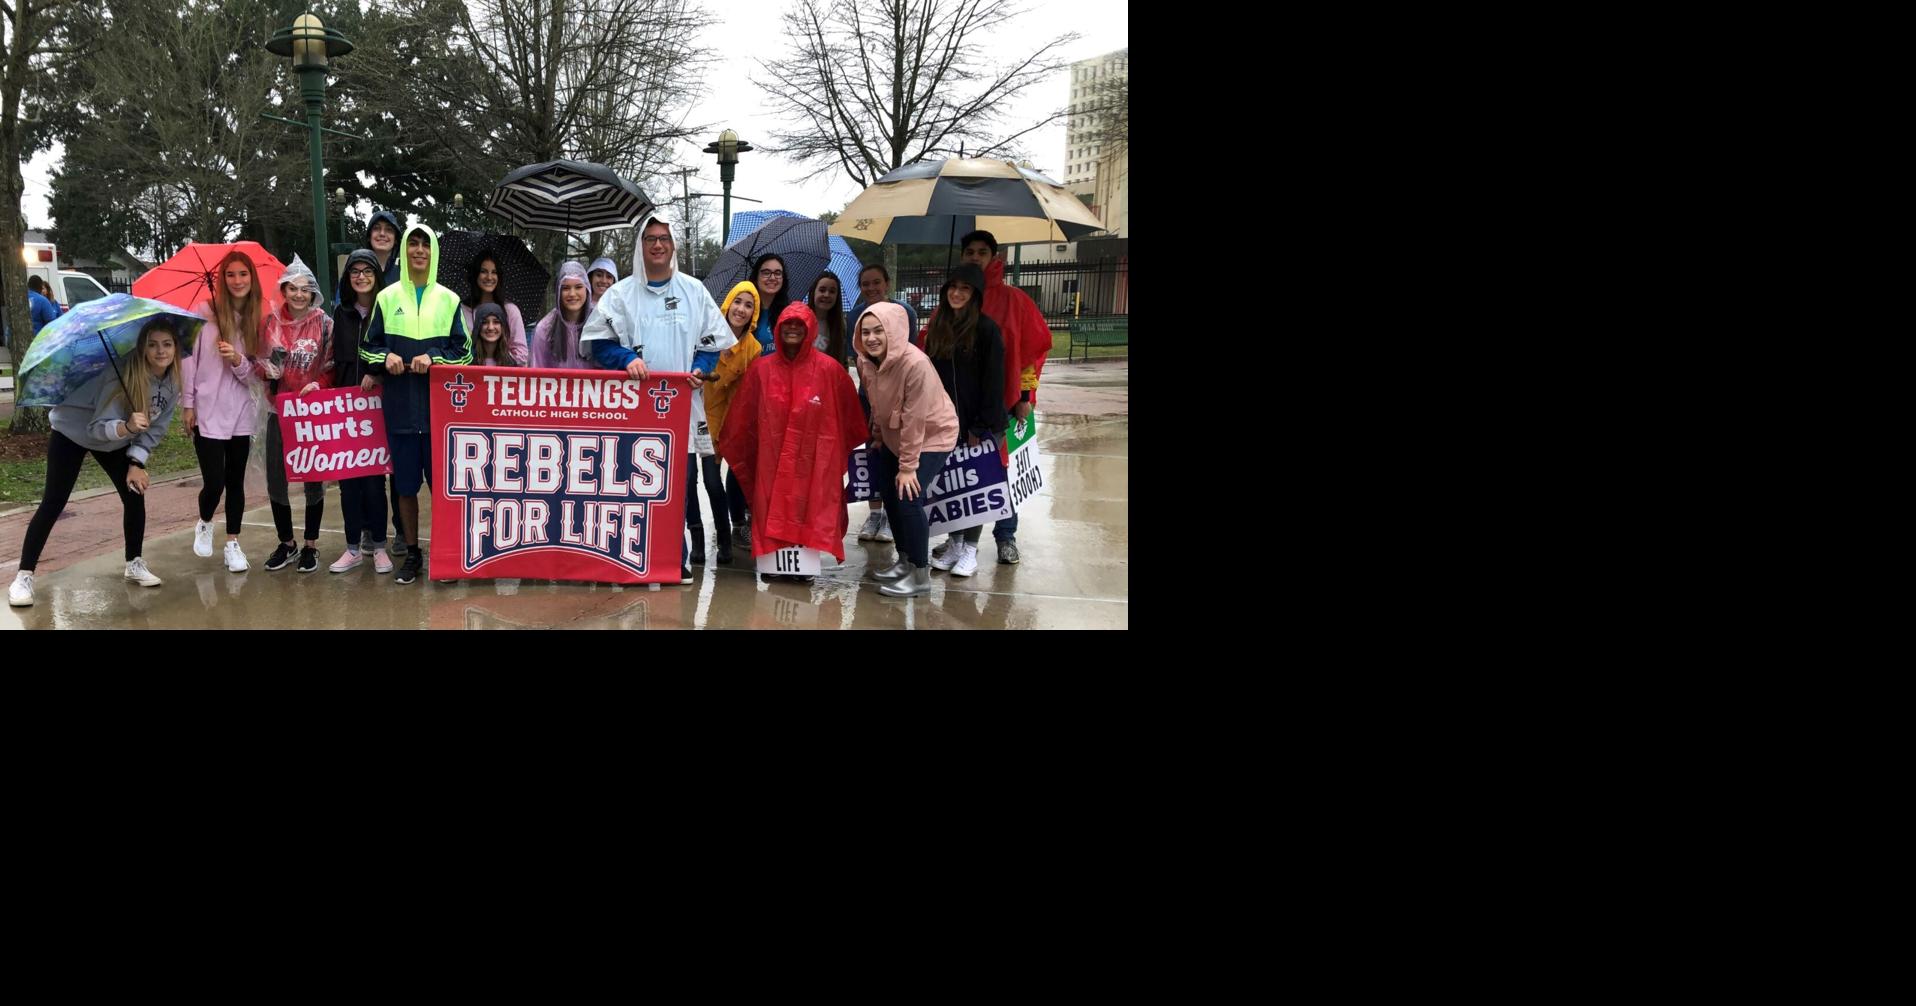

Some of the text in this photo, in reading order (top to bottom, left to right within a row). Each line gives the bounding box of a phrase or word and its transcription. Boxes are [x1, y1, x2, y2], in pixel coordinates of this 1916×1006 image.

[283, 393, 382, 417] Abortion
[483, 375, 641, 410] TEURLINGS
[295, 416, 374, 442] Hurts
[491, 408, 629, 420] CATHOLIC HIGH SCHOOL
[286, 444, 391, 474] Women
[452, 431, 666, 496] REBELS
[1015, 446, 1031, 477] LIFE
[926, 467, 979, 499] Kills
[1011, 465, 1042, 506] CHOOSE
[470, 498, 645, 567] FOR LIFE
[776, 550, 800, 572] LIFE
